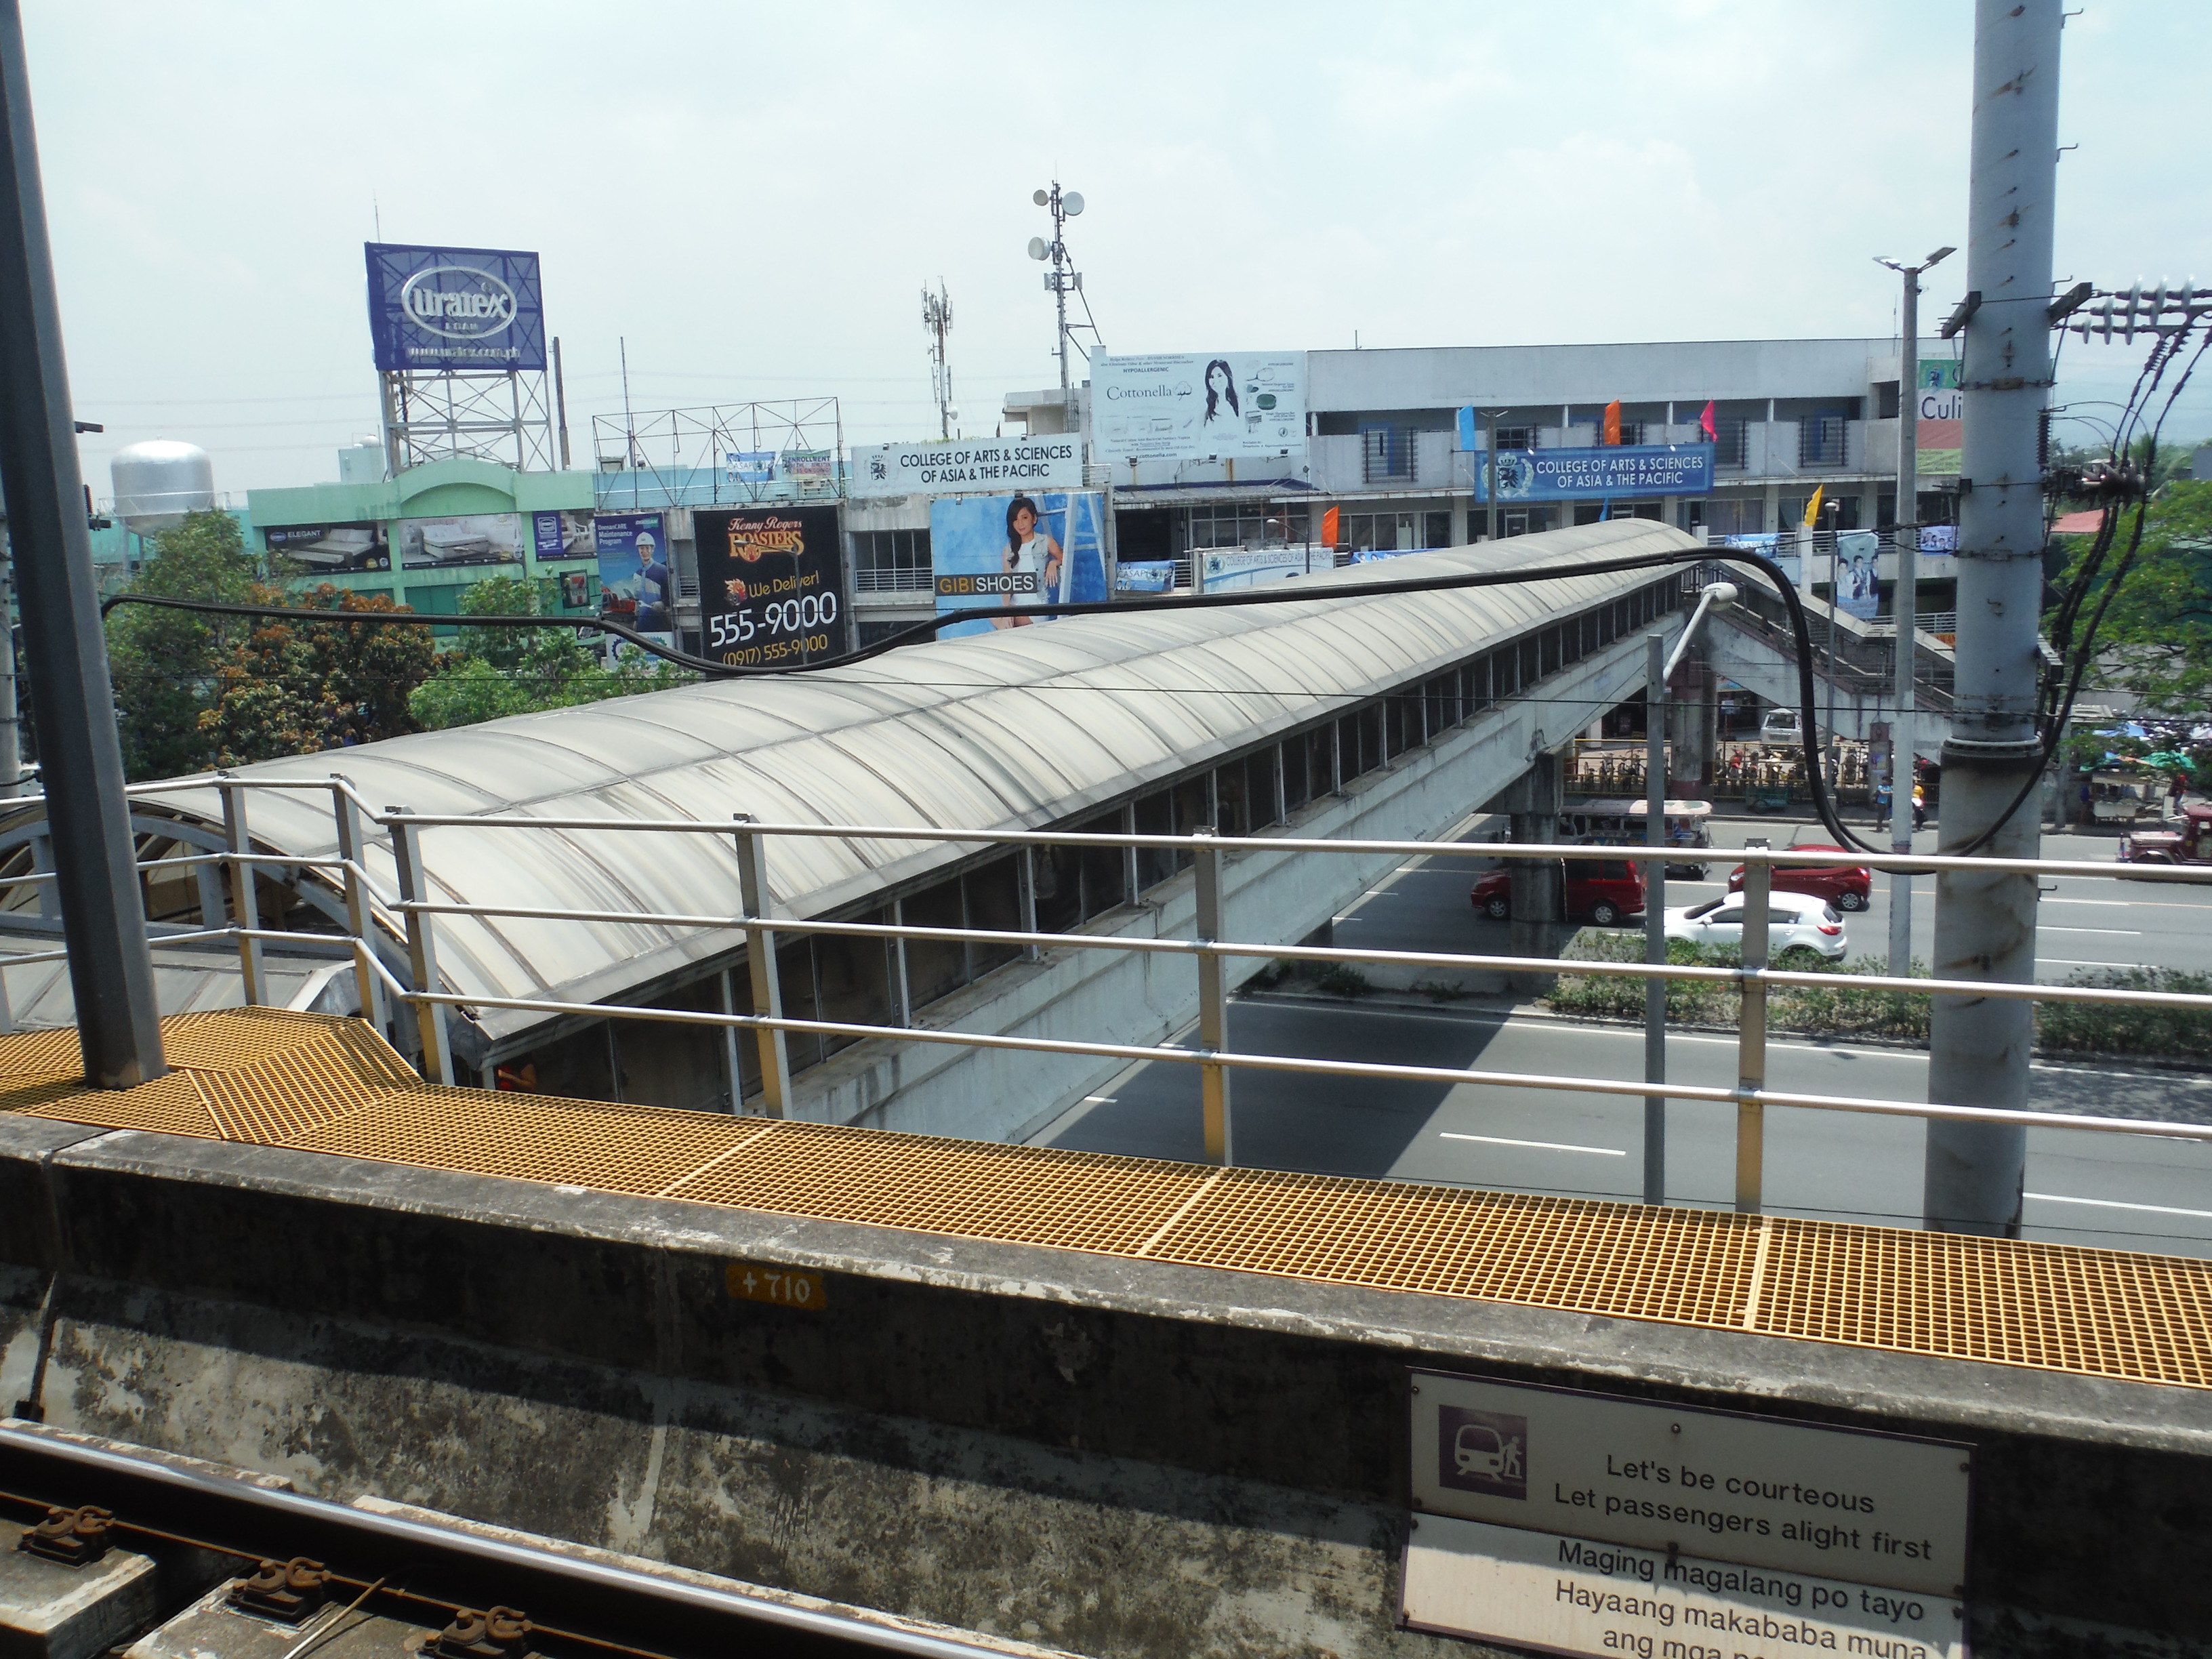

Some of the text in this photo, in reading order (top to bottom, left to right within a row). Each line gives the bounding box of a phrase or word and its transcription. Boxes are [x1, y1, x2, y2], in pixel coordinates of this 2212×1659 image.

[413, 287, 508, 318] Uratex
[1107, 385, 1172, 401] Cottonella
[901, 445, 1072, 467] COLLEGE OF ARTS & SCIENCES
[1536, 456, 1703, 474] COLLEGE OF ARTS & SCIENCES
[922, 464, 1050, 483] OF ASIA & THE PACIFIC
[1557, 472, 1683, 488] OF ASIA & THE PACIFIC
[287, 530, 321, 538] ELEGANT
[728, 516, 802, 533] Kenny Rogers
[729, 531, 804, 562] ROASTERS
[1227, 556, 1246, 566] COLLEGE
[1246, 556, 1253, 565] OF
[1254, 555, 1263, 565] ARTS
[1267, 554, 1288, 564] SCIENCES
[749, 570, 819, 598] We Deliver!
[710, 592, 837, 647] 555-9000
[722, 634, 827, 665] (0917) 555-9000
[1607, 1454, 1875, 1513] Let's be courteous
[1555, 1483, 1932, 1561] Let passengers alight first
[1559, 1539, 1925, 1623] Maging magalang po tayo
[1556, 1579, 1926, 1659] Hayaang makababa muna
[1603, 1630, 1722, 1659] ang mga
